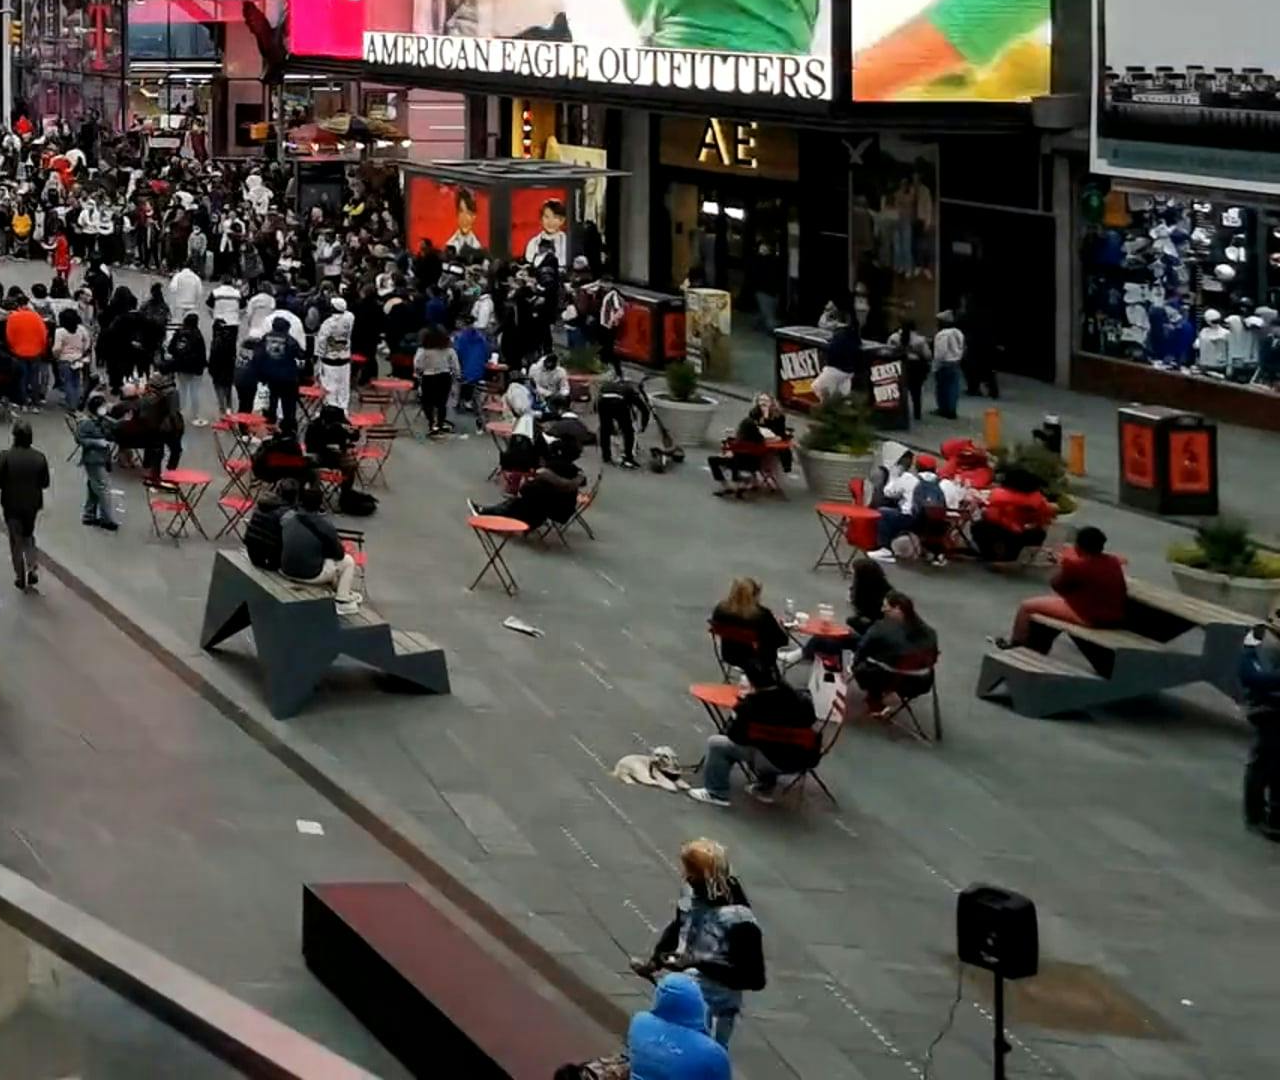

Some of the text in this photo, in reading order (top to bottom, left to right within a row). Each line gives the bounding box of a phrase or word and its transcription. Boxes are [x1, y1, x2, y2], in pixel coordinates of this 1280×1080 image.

[364, 32, 827, 100] AMERICAN EAGLE OUTFITTERS
[698, 117, 759, 169] AE
[779, 348, 821, 381] JERSEY
